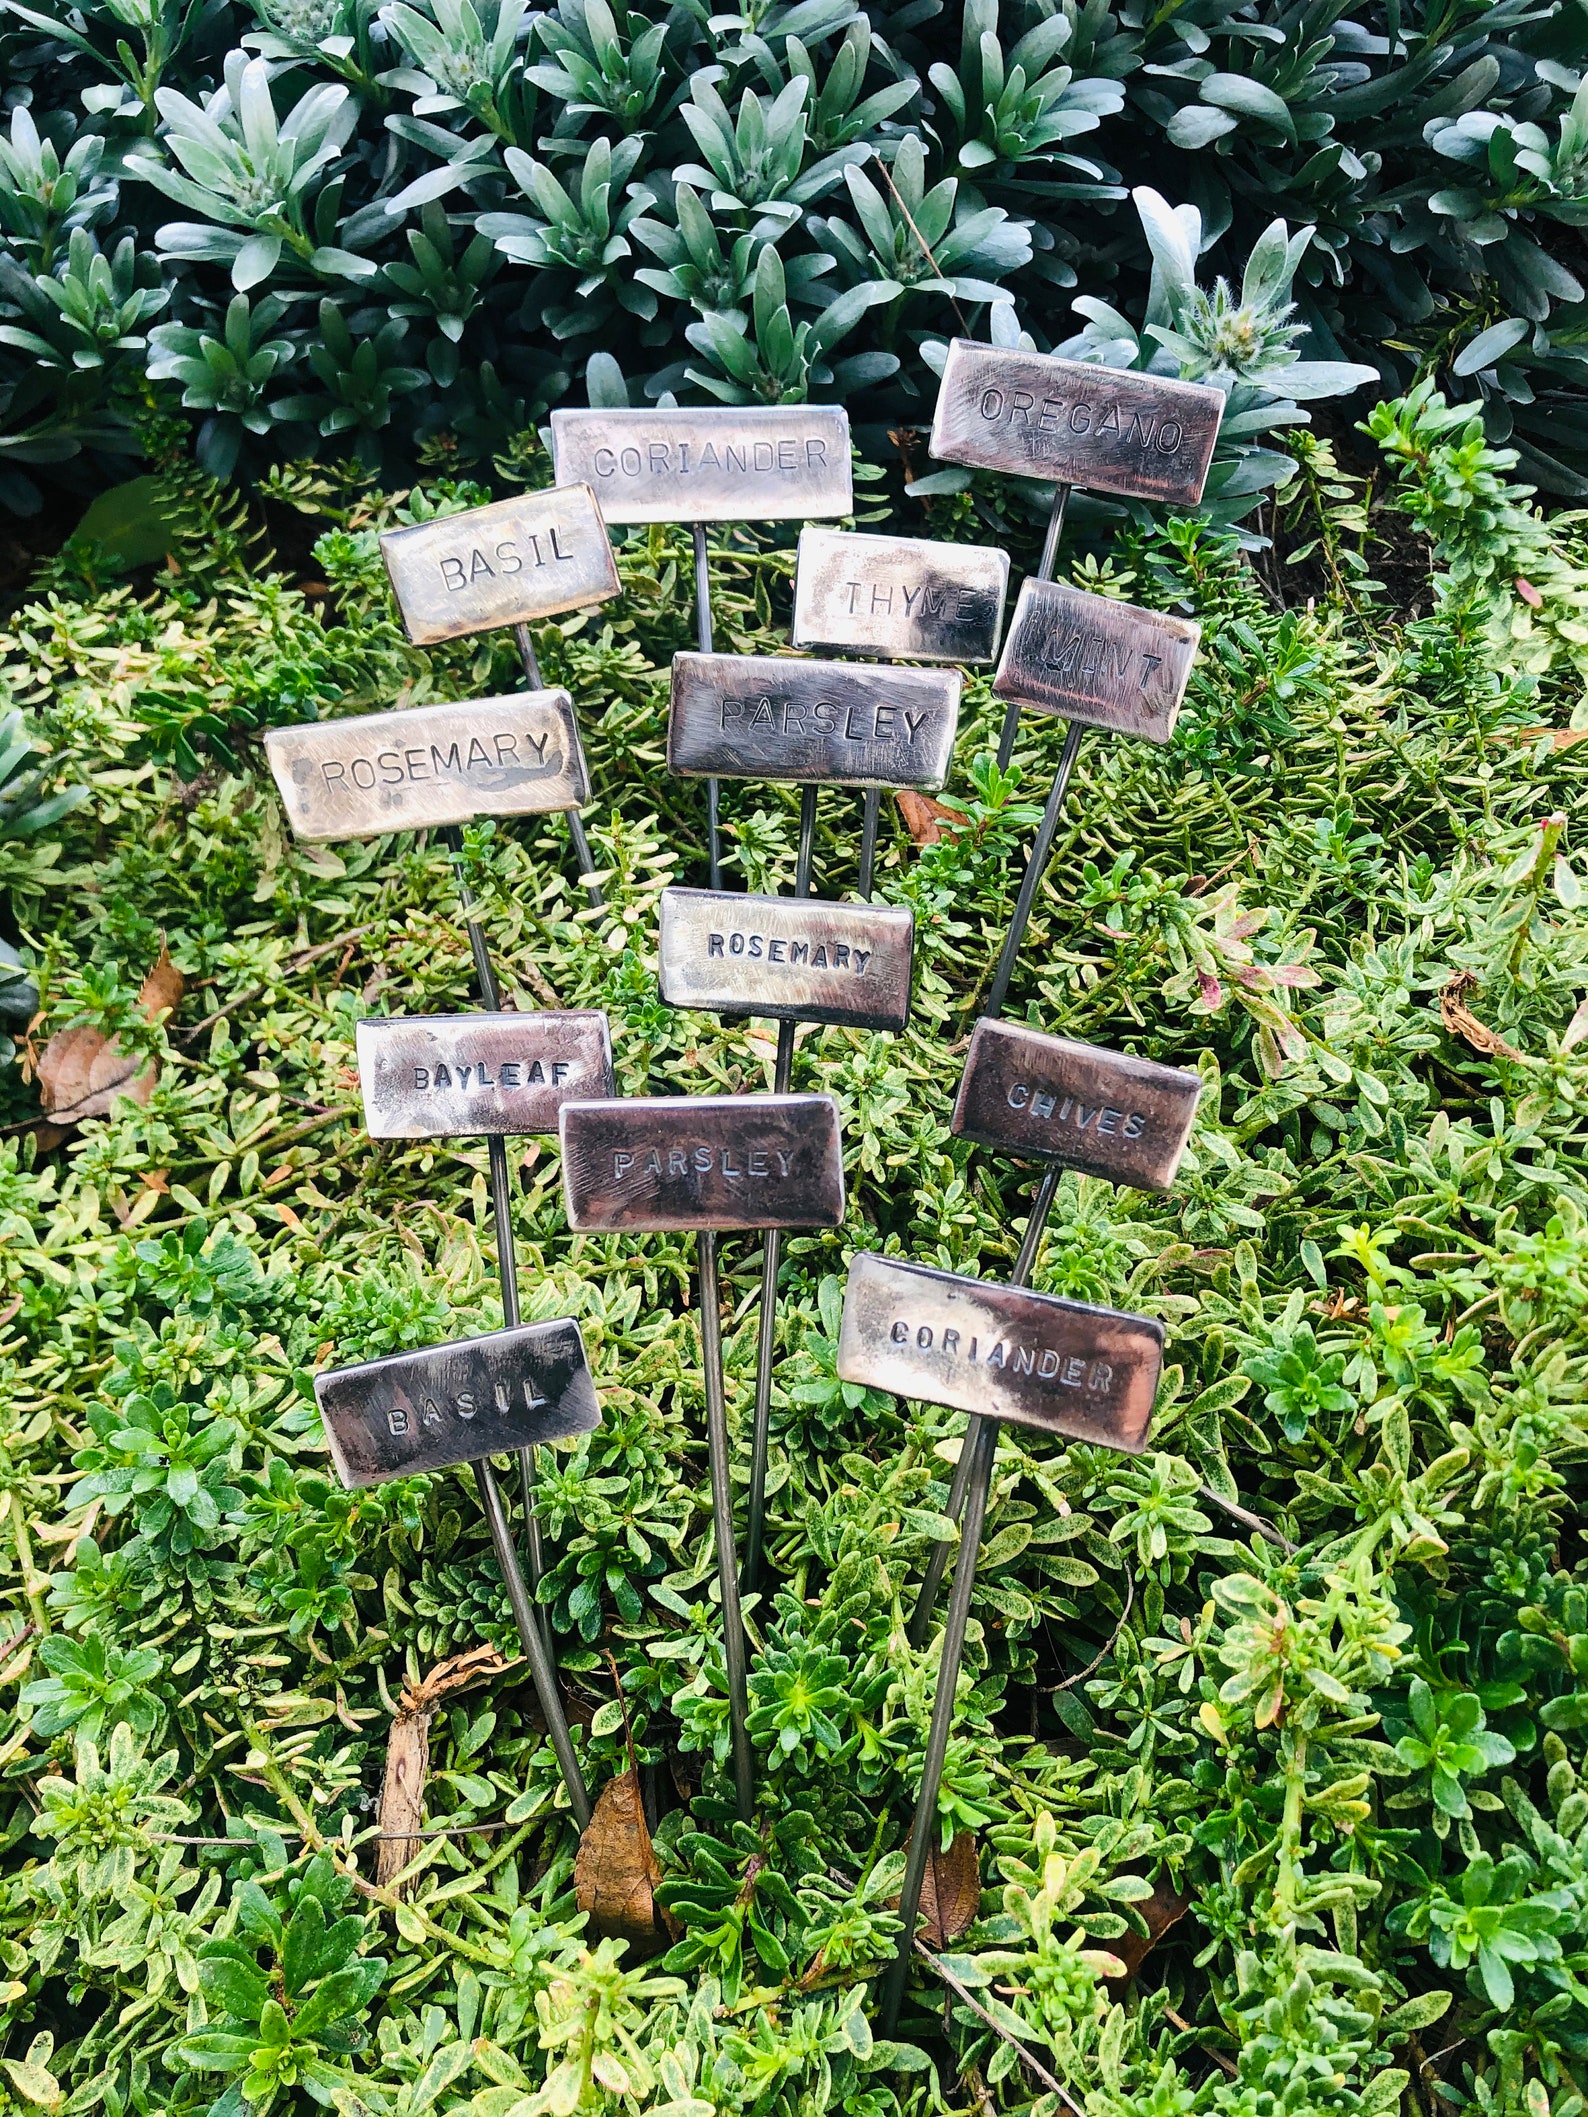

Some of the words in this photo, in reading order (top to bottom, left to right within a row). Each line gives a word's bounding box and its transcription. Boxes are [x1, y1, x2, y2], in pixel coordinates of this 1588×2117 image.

[980, 389, 1183, 454] OREGANO
[594, 439, 828, 477] CORIANDER
[440, 527, 574, 592] BASIL
[846, 581, 977, 622] THYME
[1041, 629, 1163, 689] MINT
[719, 697, 928, 745] PARSLEY
[320, 732, 549, 793] ROSEMARY
[708, 933, 871, 976] ROSEMARY
[414, 1061, 570, 1090] BAYLEAF
[1007, 1083, 1146, 1139] CHIVES
[614, 1146, 795, 1179] PARSLEY
[890, 1321, 1114, 1394] CORIANDER
[387, 1378, 548, 1436] BASIL
